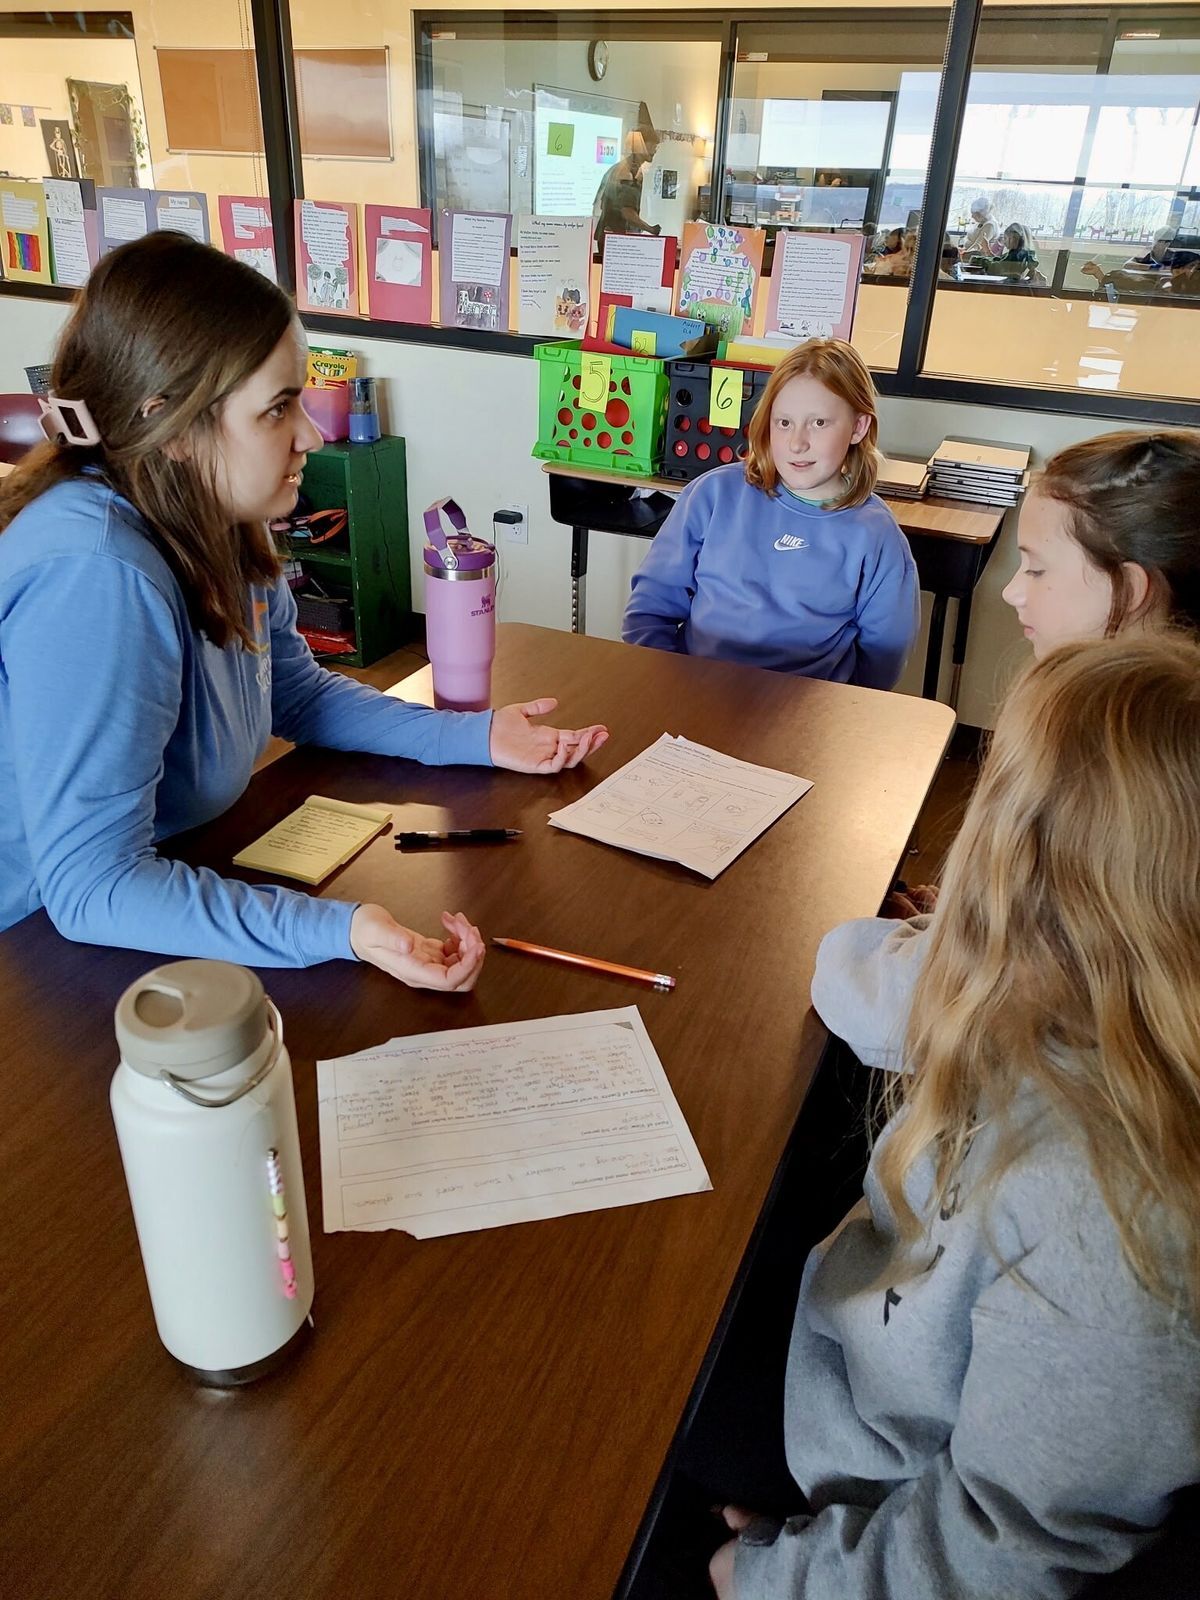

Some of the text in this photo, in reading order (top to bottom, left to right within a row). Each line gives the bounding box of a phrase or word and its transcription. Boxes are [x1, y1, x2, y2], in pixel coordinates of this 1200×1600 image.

[555, 134, 563, 151] 6
[315, 360, 345, 370] Crayola
[582, 360, 607, 403] 5
[716, 376, 733, 410] 6
[780, 533, 805, 547] NIKE
